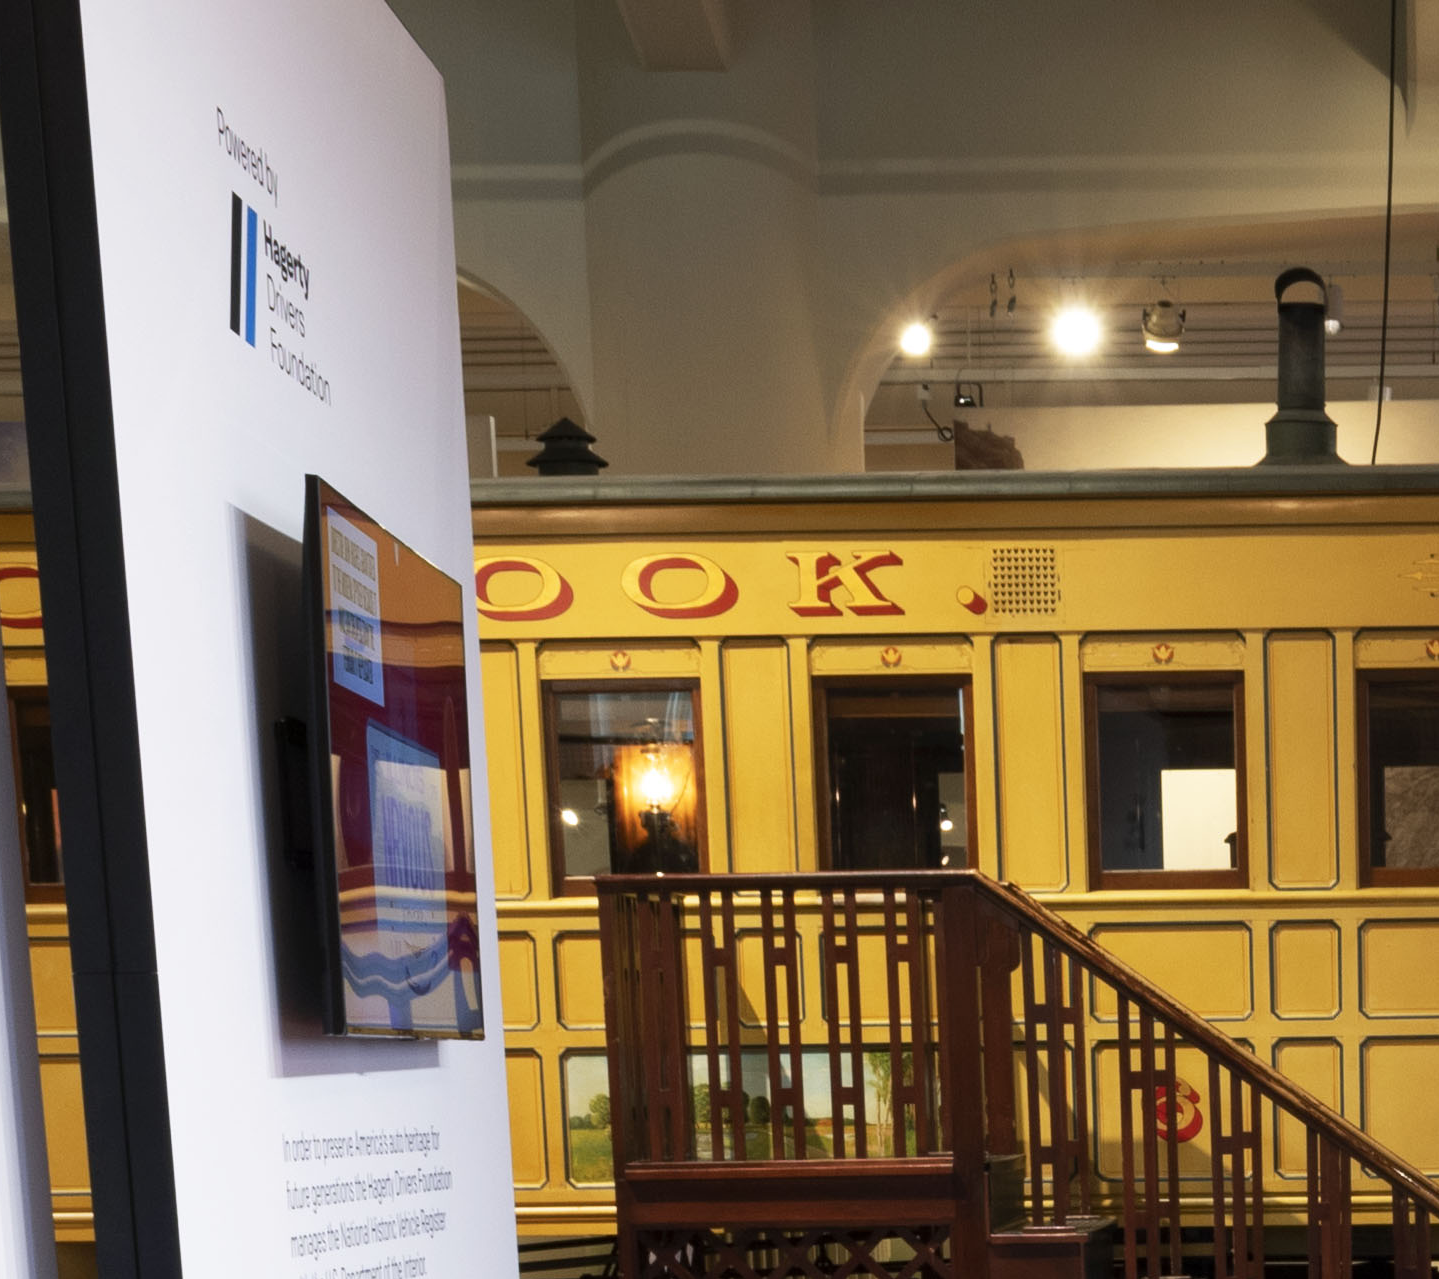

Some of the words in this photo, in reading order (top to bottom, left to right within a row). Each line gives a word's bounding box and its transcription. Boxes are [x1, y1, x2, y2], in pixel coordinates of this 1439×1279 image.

[216, 106, 265, 187] Powered
[264, 153, 278, 207] by
[263, 219, 309, 301] Hagerty
[266, 273, 306, 338] Drivers
[269, 326, 331, 406] Foundation
[282, 1133, 290, 1163] In
[292, 1132, 312, 1162] order
[313, 1133, 321, 1161] to
[322, 1135, 353, 1166] preserve
[355, 1128, 390, 1156] America's
[390, 1130, 404, 1154] auto
[404, 1126, 431, 1157] heritage
[431, 1125, 440, 1151] for
[286, 1180, 311, 1210] future
[312, 1177, 354, 1214] generations
[354, 1173, 367, 1202] the
[368, 1169, 394, 1205] Hagerty
[394, 1169, 417, 1197] Drivers
[417, 1166, 453, 1194] Foundation
[291, 1230, 326, 1261] manages
[326, 1222, 339, 1251] the
[339, 1218, 371, 1249] National
[371, 1214, 397, 1244] Historic
[396, 1210, 420, 1240] Vehicle
[419, 1208, 447, 1239] Register
